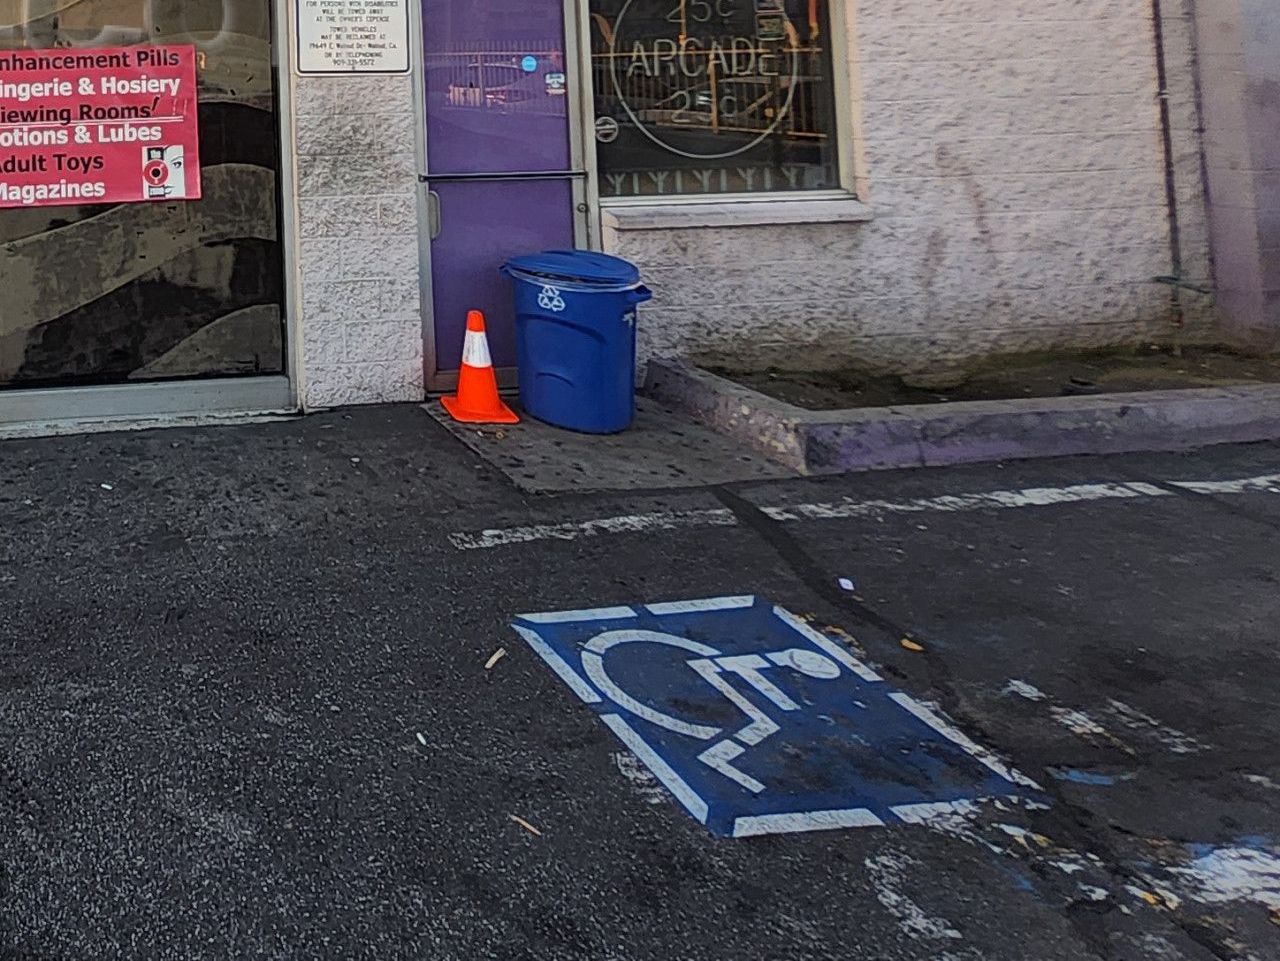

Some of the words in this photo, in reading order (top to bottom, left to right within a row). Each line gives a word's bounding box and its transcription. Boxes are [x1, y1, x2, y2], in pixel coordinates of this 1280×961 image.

[136, 50, 179, 68] Pills
[627, 37, 780, 77] ARCADE
[78, 78, 96, 95] &
[101, 74, 180, 97] Hosiery
[74, 125, 93, 143] &
[98, 123, 162, 143] Lubes
[53, 153, 104, 174] Toys
